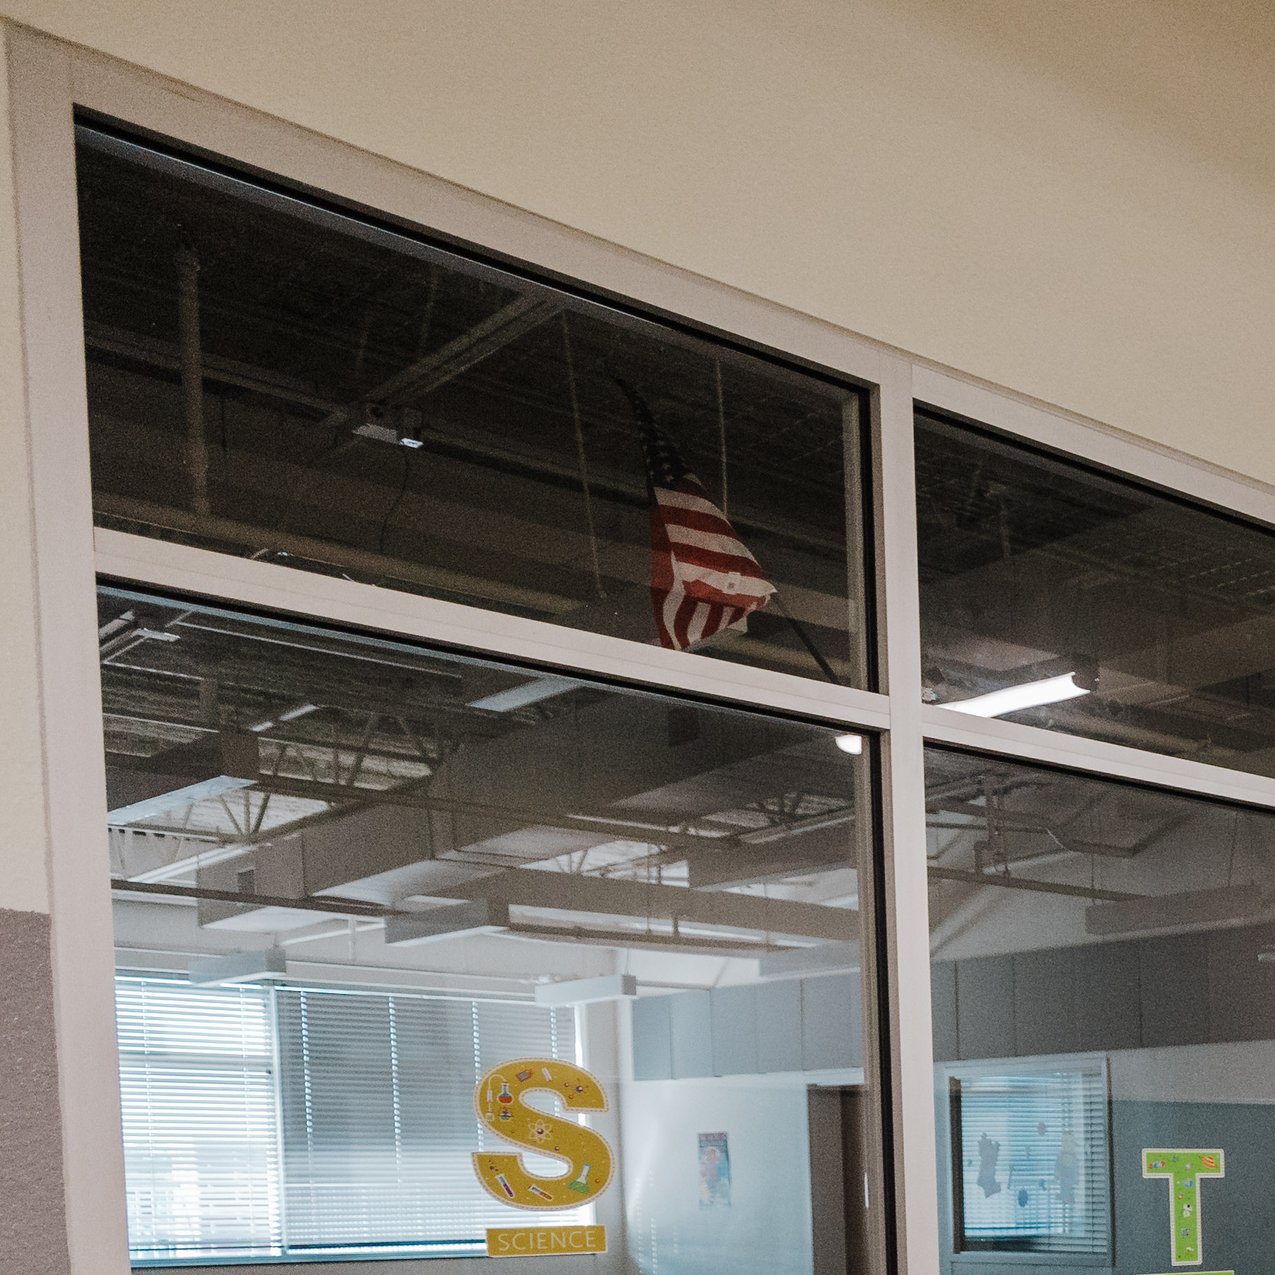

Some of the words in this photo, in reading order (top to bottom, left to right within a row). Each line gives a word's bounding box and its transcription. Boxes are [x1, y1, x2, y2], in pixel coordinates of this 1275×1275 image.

[472, 1057, 615, 1212] S
[498, 1229, 597, 1251] SCIENCE
[1141, 1148, 1225, 1267] T
